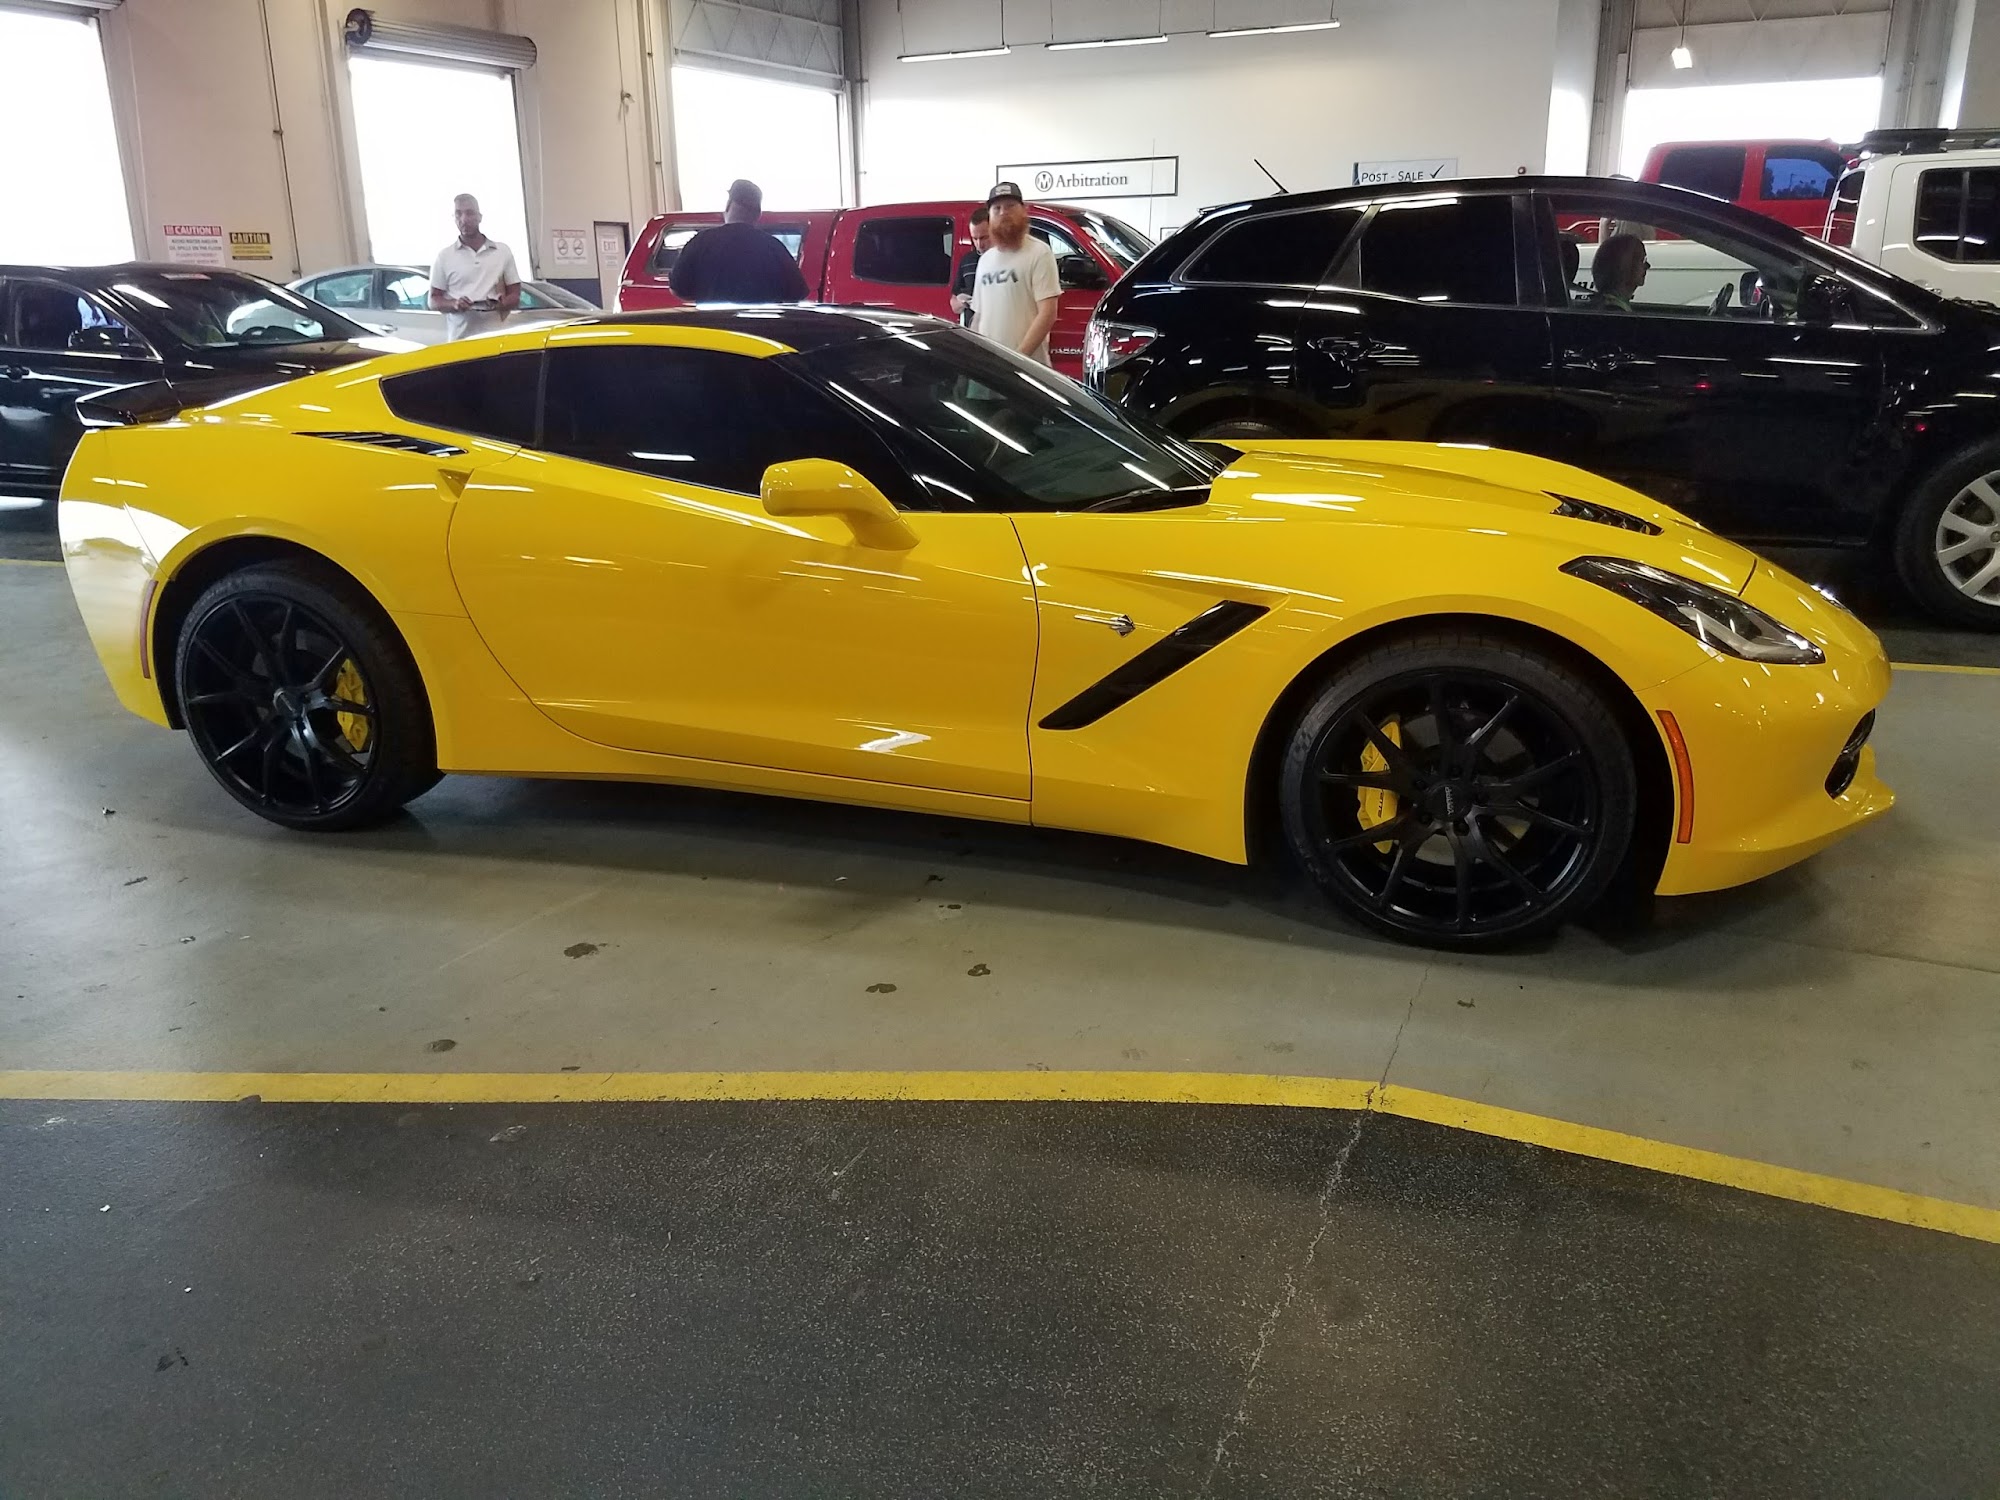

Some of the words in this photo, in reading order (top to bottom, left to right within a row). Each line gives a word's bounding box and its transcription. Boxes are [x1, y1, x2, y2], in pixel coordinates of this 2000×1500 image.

[1055, 172, 1128, 188] Arbitration
[1361, 172, 1389, 182] POST
[1397, 171, 1424, 181] SALE
[174, 226, 211, 235] CAUTION
[231, 232, 268, 244] CAUTION
[603, 241, 616, 251] EXIT
